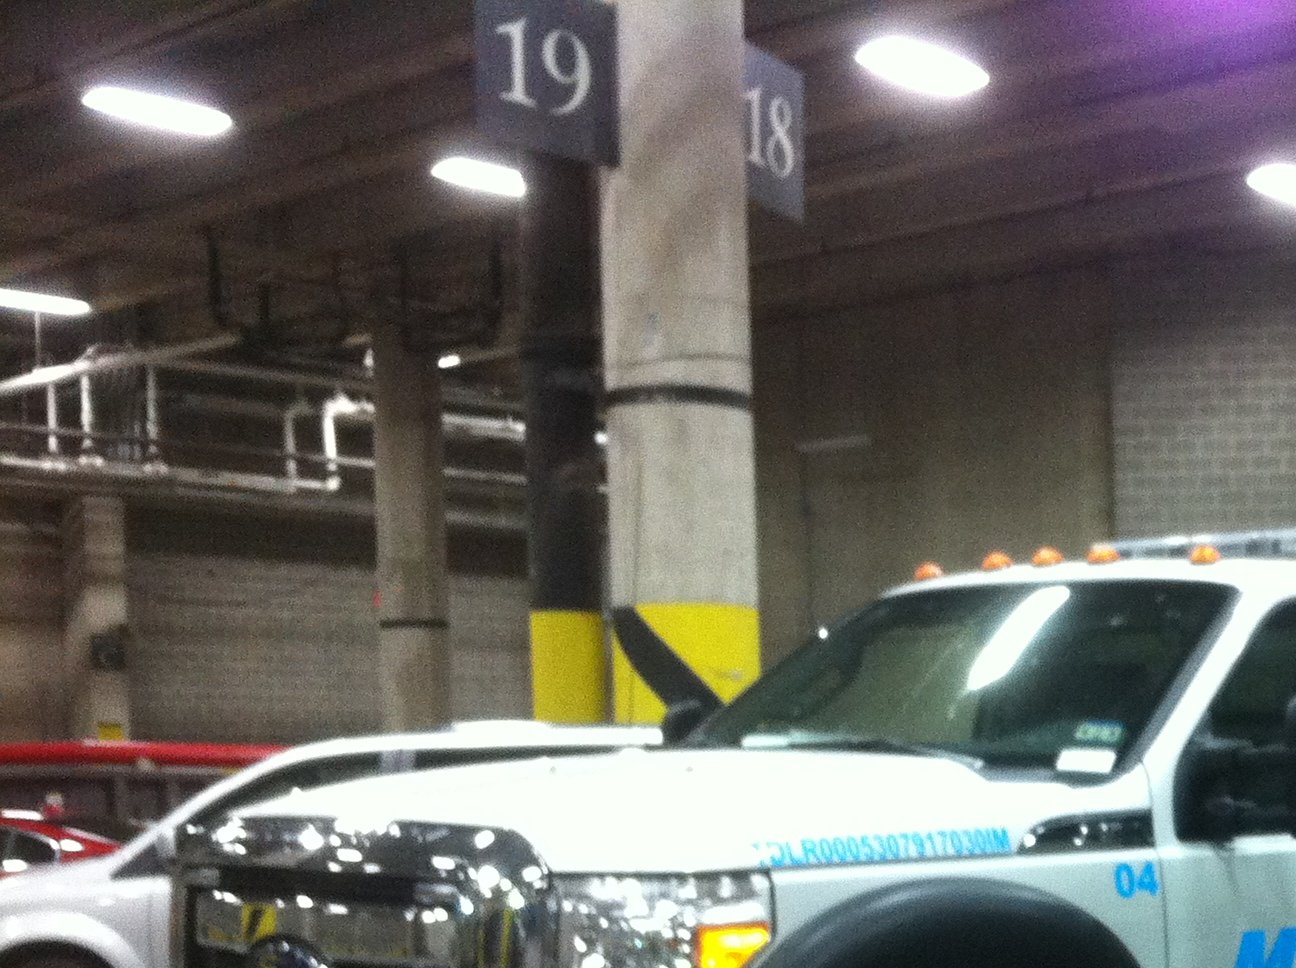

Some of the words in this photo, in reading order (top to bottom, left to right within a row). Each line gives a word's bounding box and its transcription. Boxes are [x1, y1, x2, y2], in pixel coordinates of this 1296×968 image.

[495, 17, 593, 117] 19
[744, 87, 795, 179] 18
[1114, 860, 1160, 899] 04
